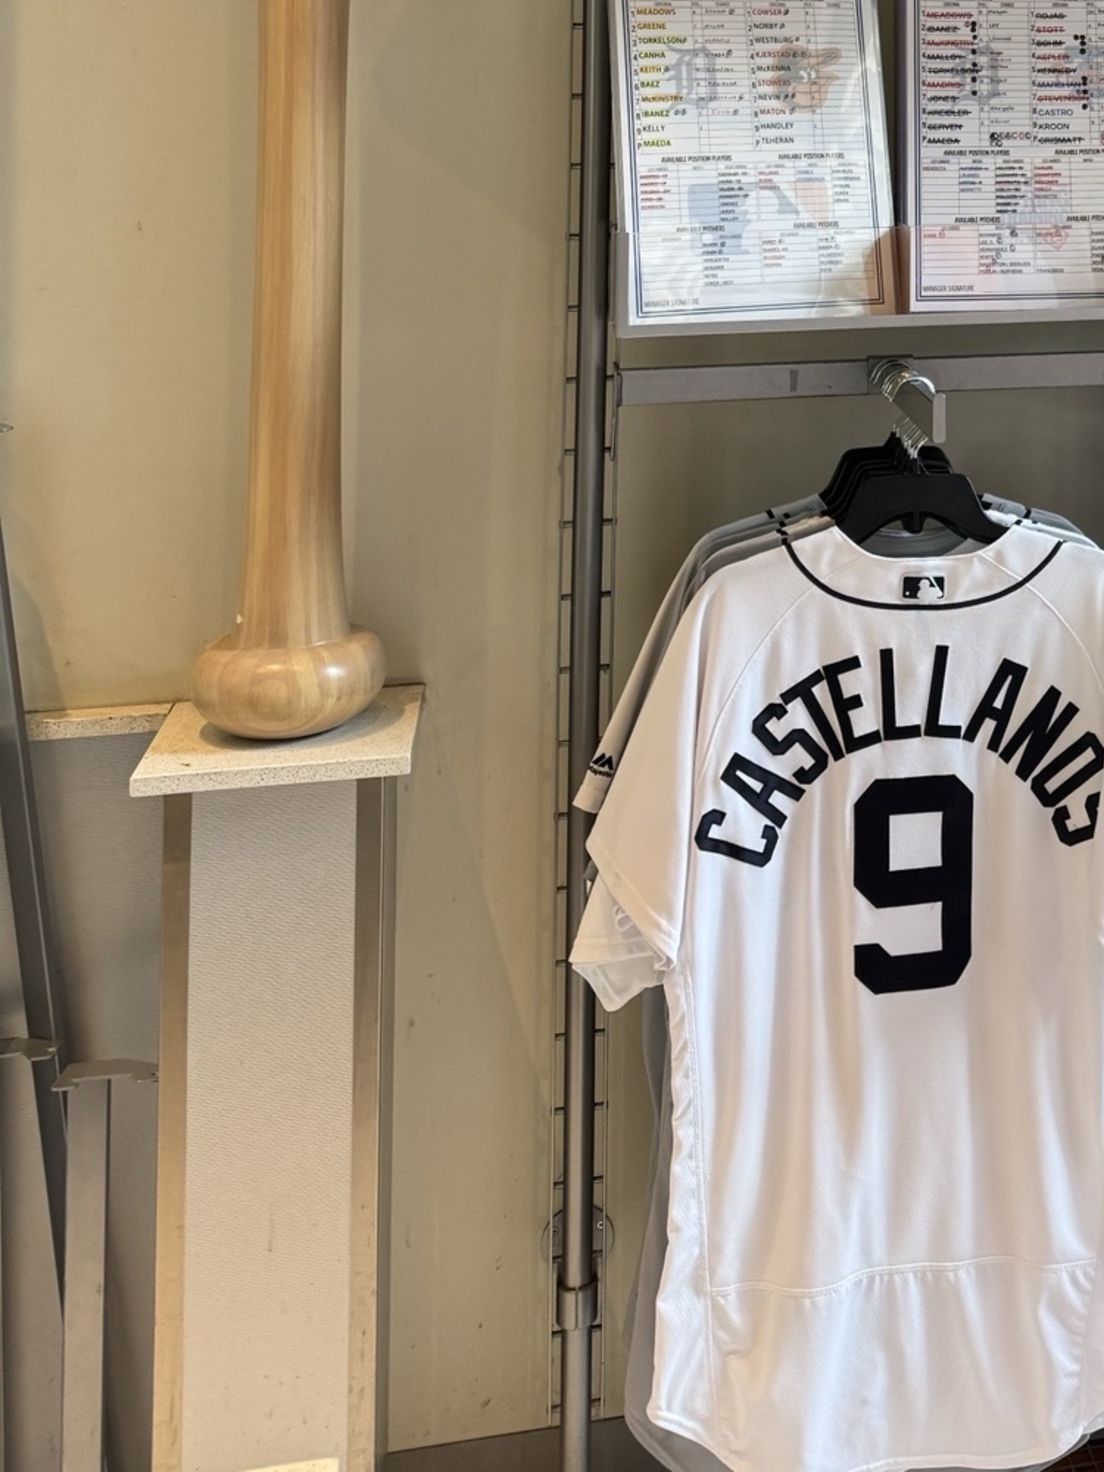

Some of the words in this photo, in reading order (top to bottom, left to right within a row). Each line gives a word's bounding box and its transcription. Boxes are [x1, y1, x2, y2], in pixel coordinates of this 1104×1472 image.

[636, 7, 676, 16] MEADOWS
[752, 8, 782, 16] COWSER
[637, 22, 666, 30] GREENE
[639, 51, 666, 59] CANHA
[759, 108, 786, 116] MATON
[1038, 108, 1073, 116] CASTRO
[760, 122, 794, 130] HANDLEY
[1038, 122, 1070, 130] KROON
[643, 139, 672, 147] MAEDA
[853, 774, 975, 995] 9
